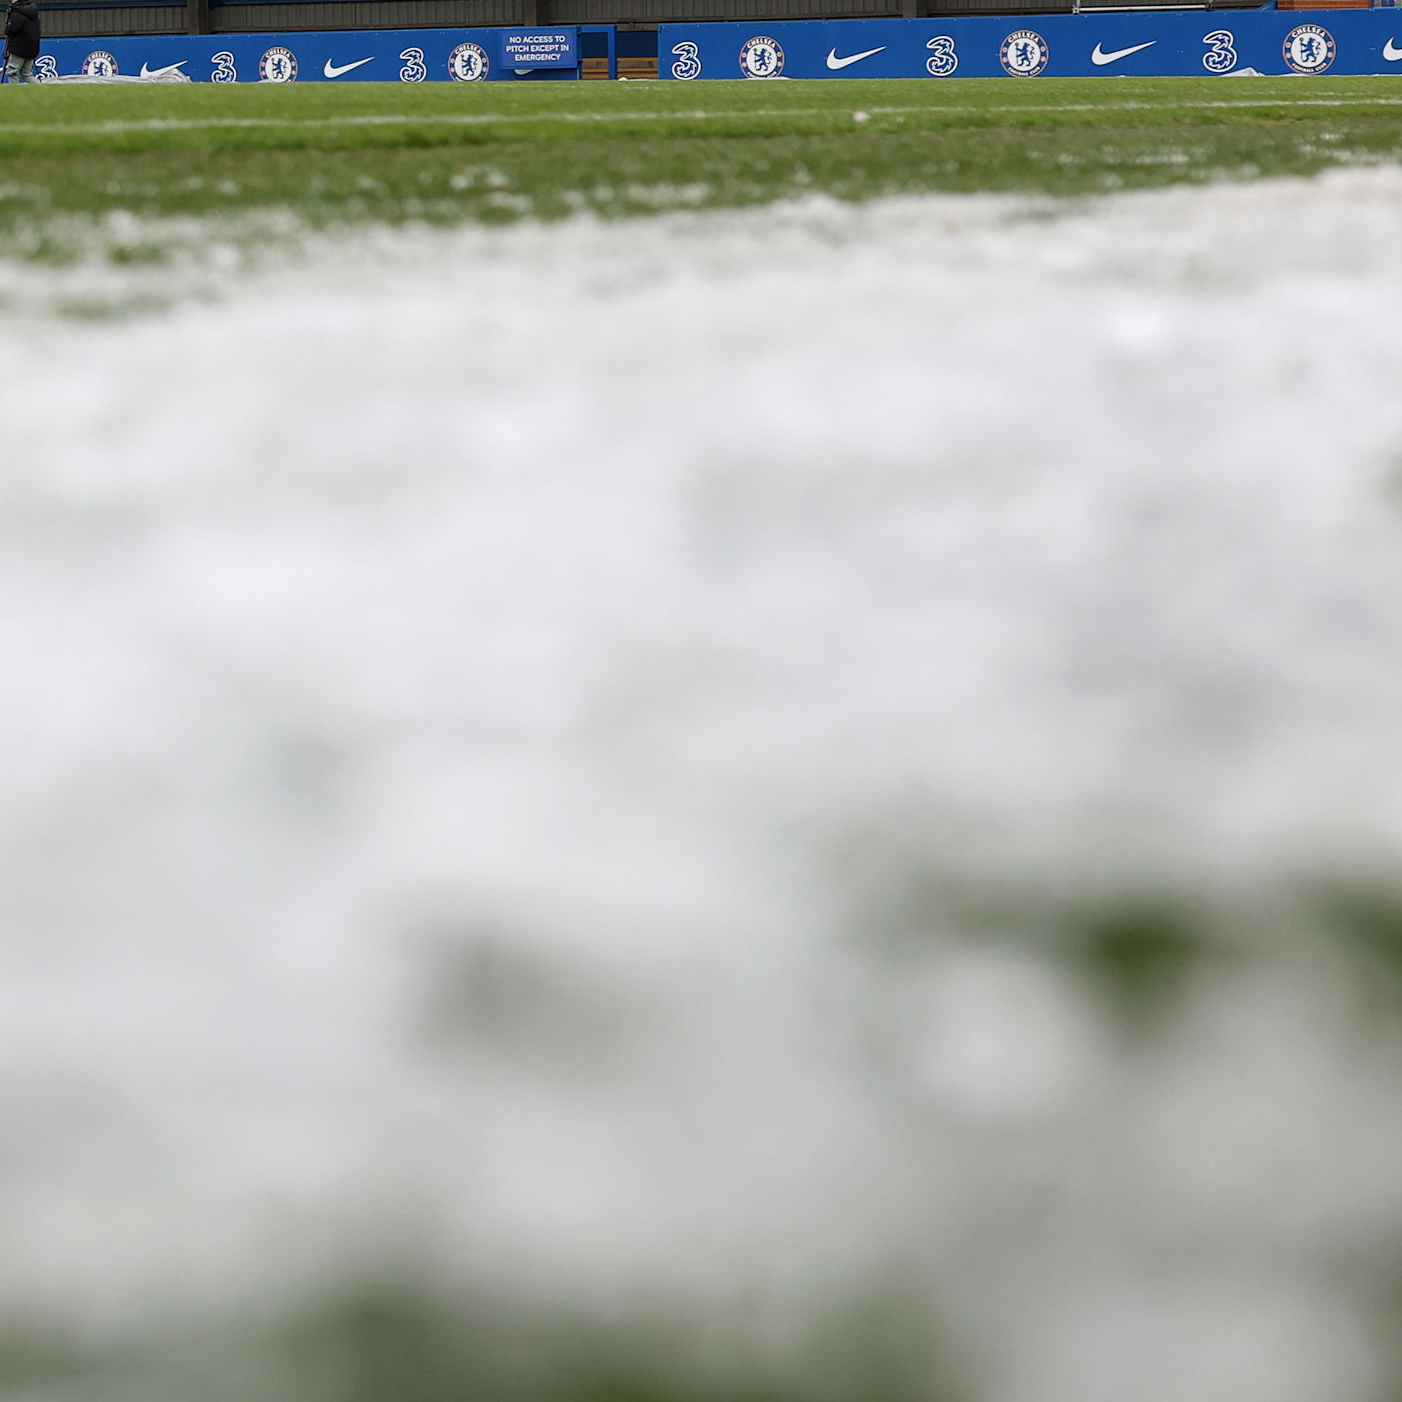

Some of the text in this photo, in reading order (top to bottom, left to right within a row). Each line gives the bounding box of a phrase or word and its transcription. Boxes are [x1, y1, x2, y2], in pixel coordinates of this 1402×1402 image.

[1008, 31, 1040, 43] CHELSEA
[1292, 26, 1326, 38] CHELSEA
[522, 35, 554, 43] ACCESS
[554, 35, 566, 43] TO
[747, 38, 776, 48] CHELSEA
[455, 44, 481, 55] CHELSEA
[530, 44, 560, 52] EXCEPT
[514, 53, 561, 61] EMERGENCY
